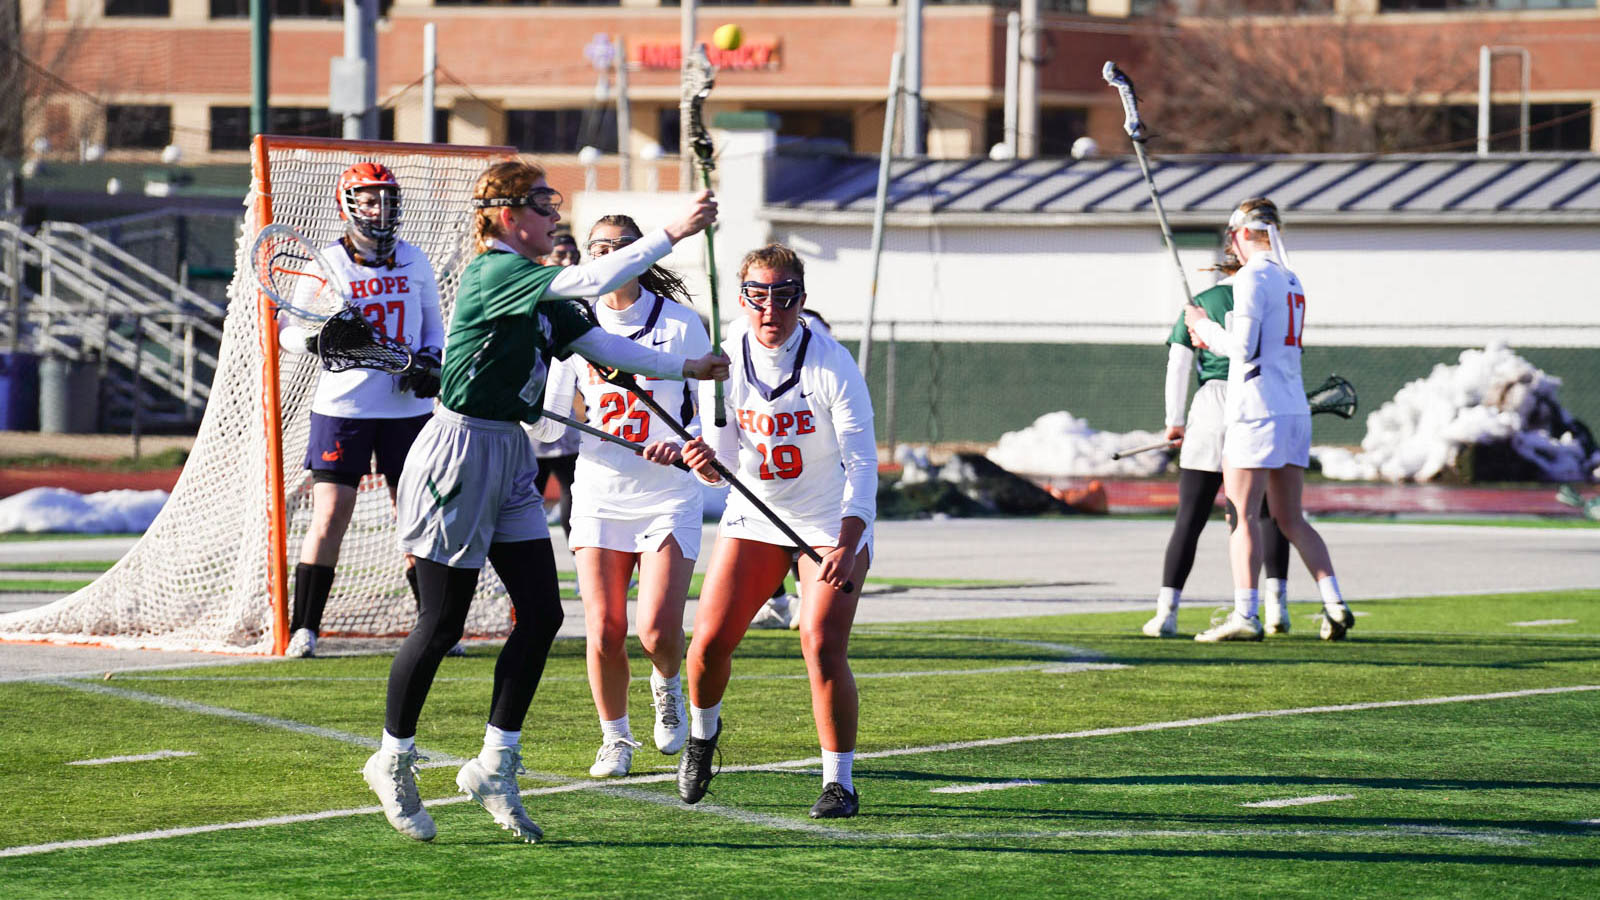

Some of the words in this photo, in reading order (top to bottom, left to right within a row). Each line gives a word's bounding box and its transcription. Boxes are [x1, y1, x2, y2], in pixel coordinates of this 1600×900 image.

[349, 276, 410, 299] HOPE
[363, 300, 406, 346] 37
[1284, 291, 1306, 348] 17
[600, 390, 653, 443] 25
[736, 408, 816, 437] HOPE
[756, 443, 803, 480] 19
